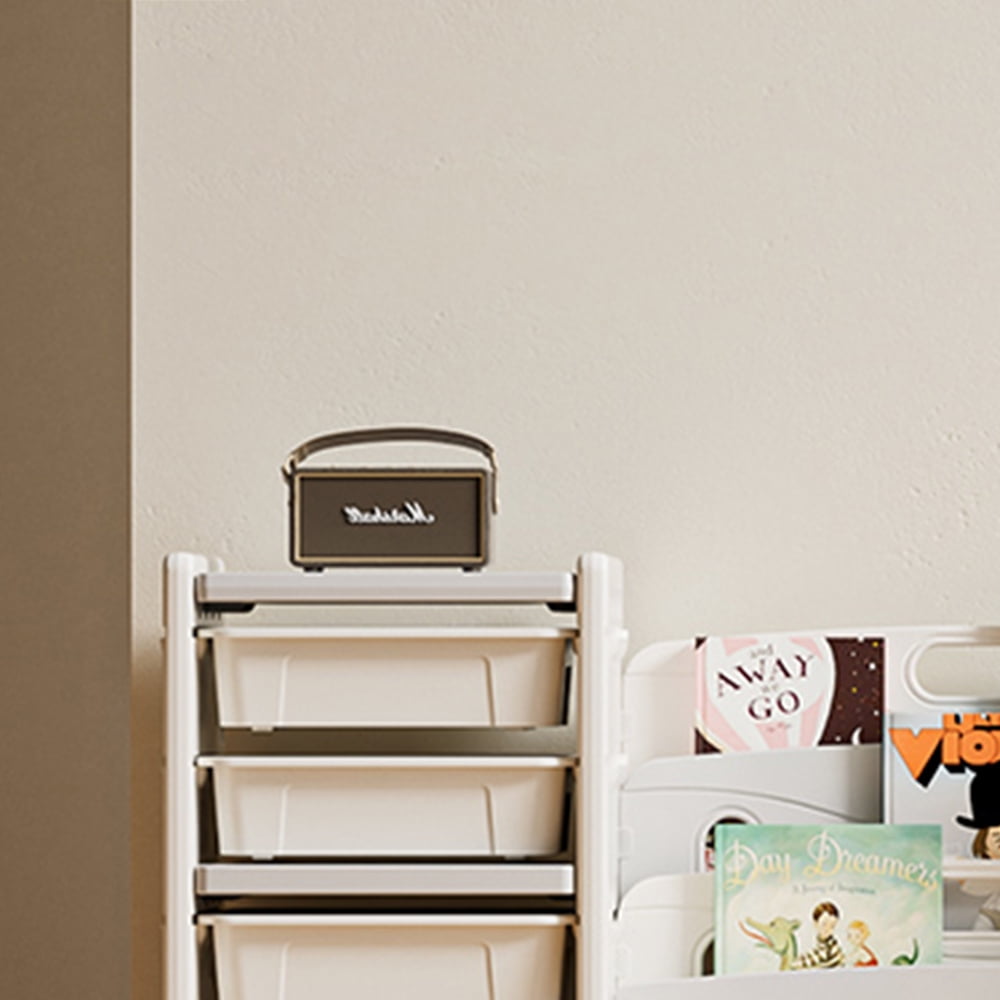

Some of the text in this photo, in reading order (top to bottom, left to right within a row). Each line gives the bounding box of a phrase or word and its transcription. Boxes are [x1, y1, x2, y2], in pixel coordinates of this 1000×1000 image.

[717, 655, 814, 698] AWAY
[748, 690, 800, 720] GO
[724, 829, 939, 891] Day Dreamers
